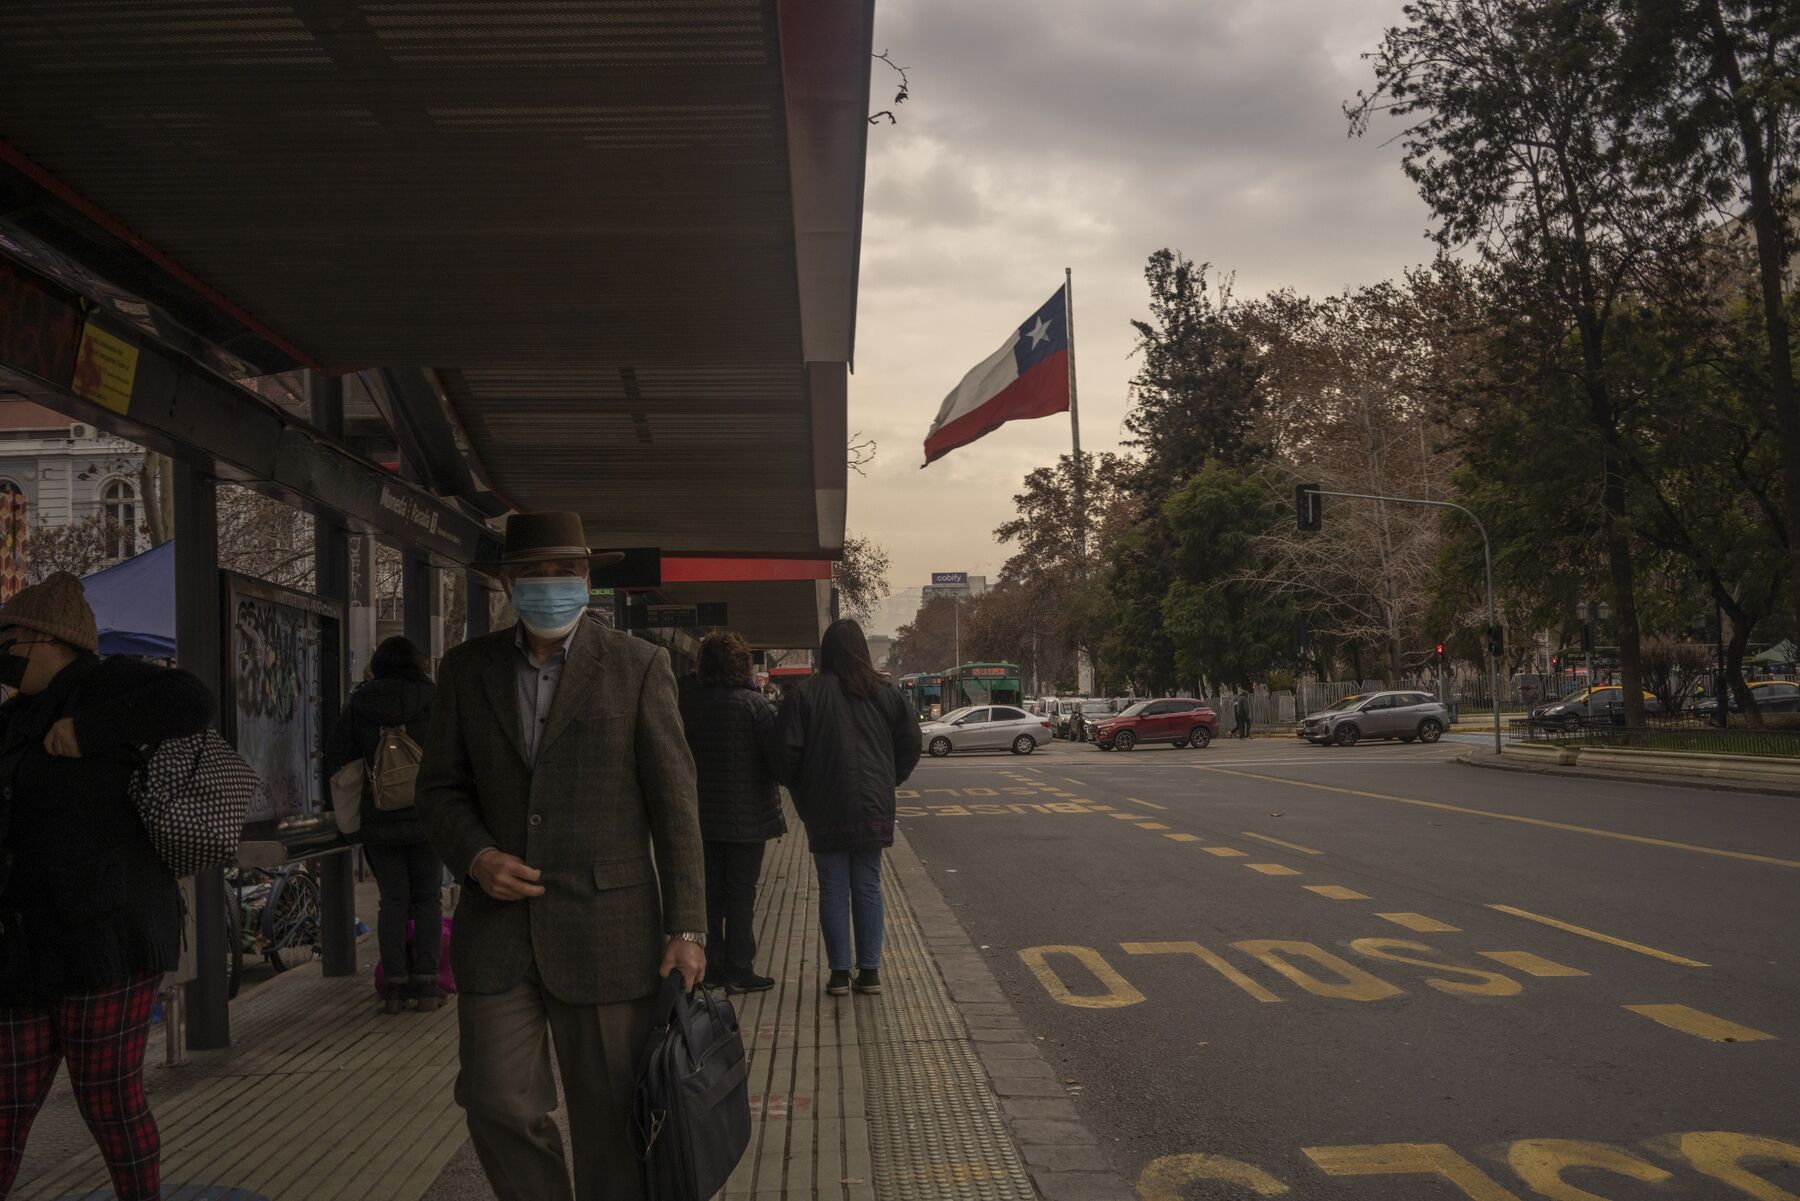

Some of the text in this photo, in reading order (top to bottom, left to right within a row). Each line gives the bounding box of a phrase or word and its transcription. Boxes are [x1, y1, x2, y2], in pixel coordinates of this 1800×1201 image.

[936, 573, 961, 583] cabify
[895, 787, 1038, 799] SOLO
[895, 802, 1093, 817] BUSES
[1019, 937, 1523, 1008] SOLO
